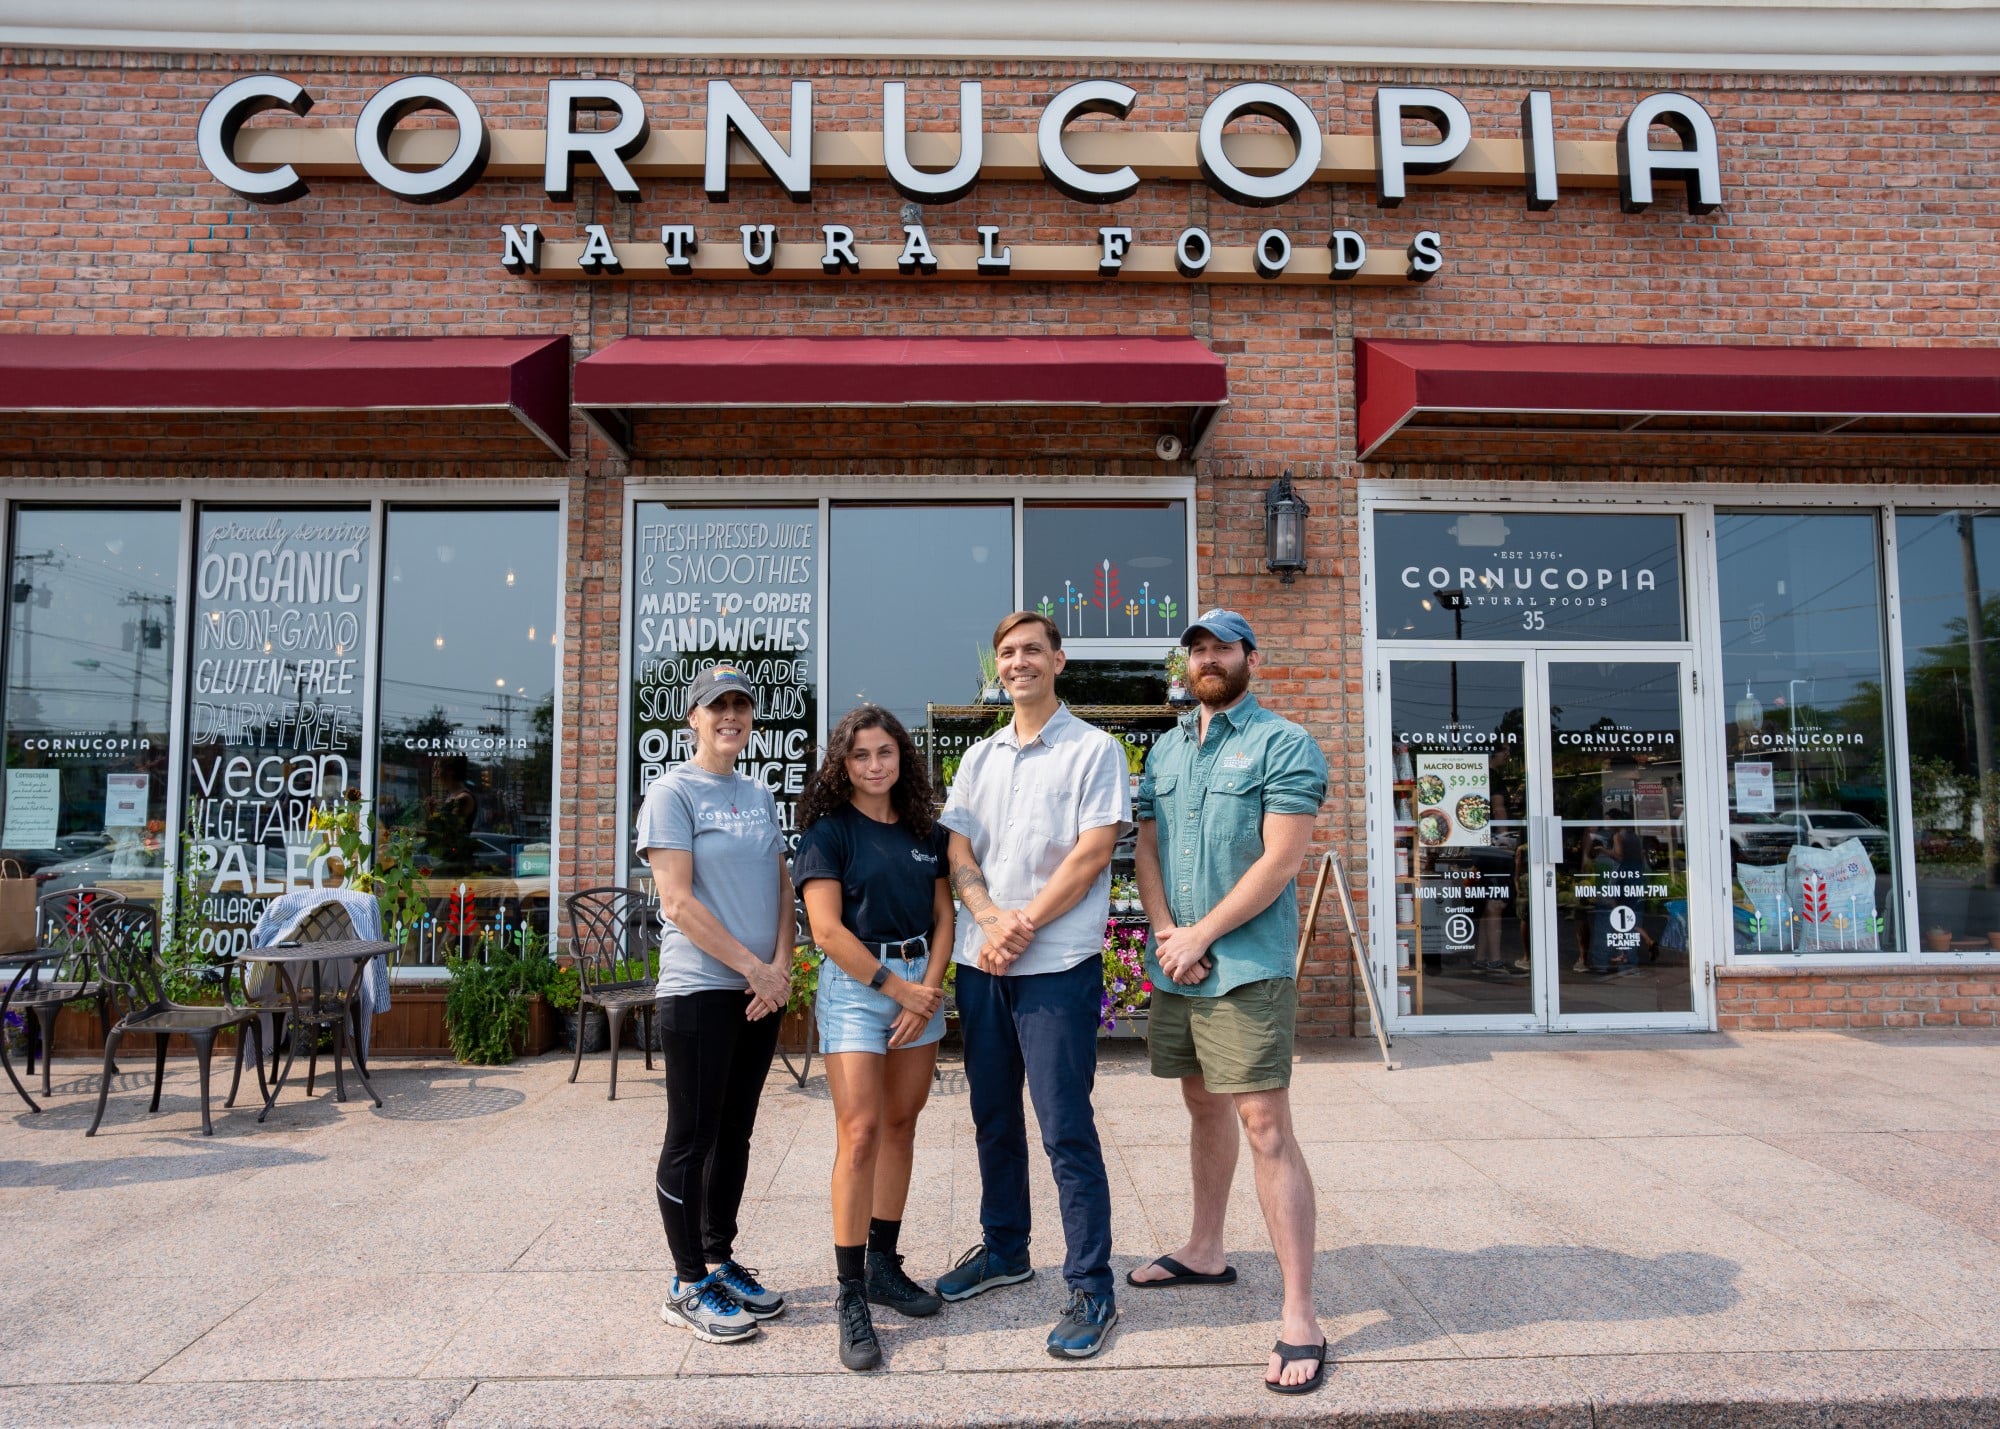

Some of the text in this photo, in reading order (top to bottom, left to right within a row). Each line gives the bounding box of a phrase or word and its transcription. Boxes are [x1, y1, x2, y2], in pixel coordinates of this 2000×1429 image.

[197, 75, 1723, 215] CORNUCOPIA
[500, 223, 1443, 283] NATURAL FOODS
[205, 516, 370, 556] proudly serving
[642, 523, 812, 553] FRESH-PRESSED JUICE
[1501, 551, 1556, 560] EST 1976
[198, 548, 362, 604] ORGANIC
[640, 553, 812, 586] & SMOOTHIES
[1401, 566, 1656, 591] CORNUCOPIA
[639, 591, 812, 615] MADE-TO-ORDER
[1452, 596, 1607, 607] NATURAL FOODS
[1522, 610, 1545, 631] 35
[200, 608, 360, 652] NON-GMO
[638, 616, 811, 653] SANDWICHES
[196, 658, 358, 696] GLUTEN-FREE
[192, 701, 353, 752] DAIRY-FREE
[24, 738, 151, 750] CORNUCOPIA
[404, 738, 527, 749] CORNUCOPIA
[1399, 732, 1517, 744] CORNUCOPIA
[1558, 733, 1675, 745] CORNUCOPIA
[1750, 733, 1864, 745] CORNUCOPIA
[1423, 762, 1483, 770] MACRO BOWLS
[1449, 775, 1488, 787] $9.99
[1443, 871, 1482, 880] HOURS
[1603, 870, 1640, 879] HOURS
[1414, 886, 1510, 899] MON-SUN 9AM-7PM
[1574, 884, 1668, 898] MON-SUN 9AM-7PM
[1444, 906, 1474, 914] Certified
[1453, 919, 1468, 938] B
[1606, 932, 1640, 940] FOR THE
[1606, 939, 1641, 947] PLANET
